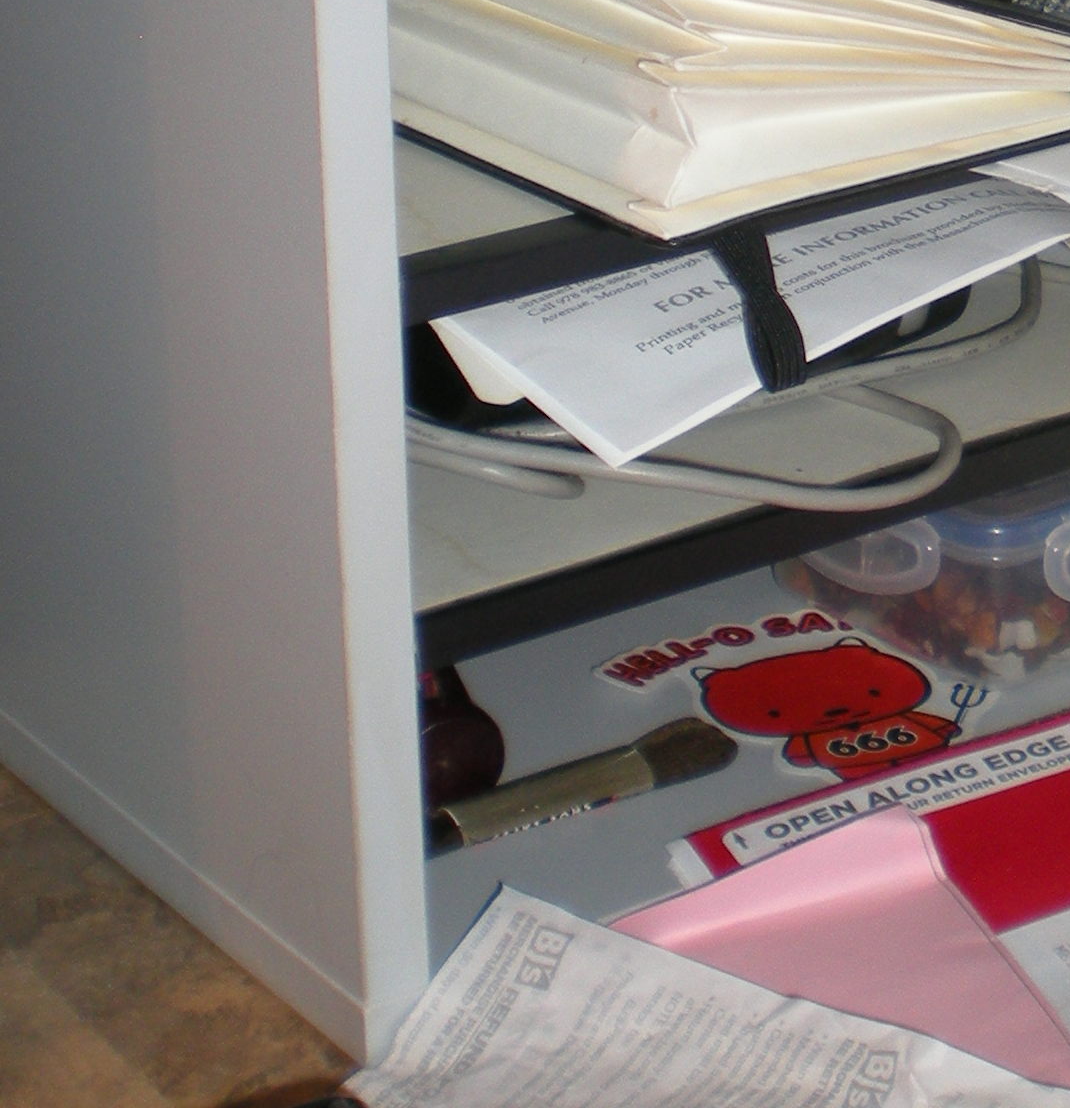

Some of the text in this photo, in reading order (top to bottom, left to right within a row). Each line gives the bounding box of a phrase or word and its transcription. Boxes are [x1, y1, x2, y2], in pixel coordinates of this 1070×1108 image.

[653, 285, 714, 314] FOR
[794, 193, 968, 257] INFORMATION
[781, 269, 817, 287] costs
[818, 258, 839, 273] for
[839, 249, 863, 264] this
[866, 230, 925, 256] brochure
[926, 207, 983, 236] provided
[541, 301, 596, 324] Avenue,
[597, 277, 649, 301] Monday
[634, 308, 726, 353] Printing and
[662, 330, 708, 356] Paper
[793, 259, 871, 294] conjunction
[872, 244, 903, 261] with
[904, 238, 925, 253] the
[826, 725, 918, 758] 666
[764, 799, 859, 840] OPEN
[866, 763, 979, 809] ALONG
[931, 777, 996, 803] RETURN
[452, 986, 519, 1074] REFUND
